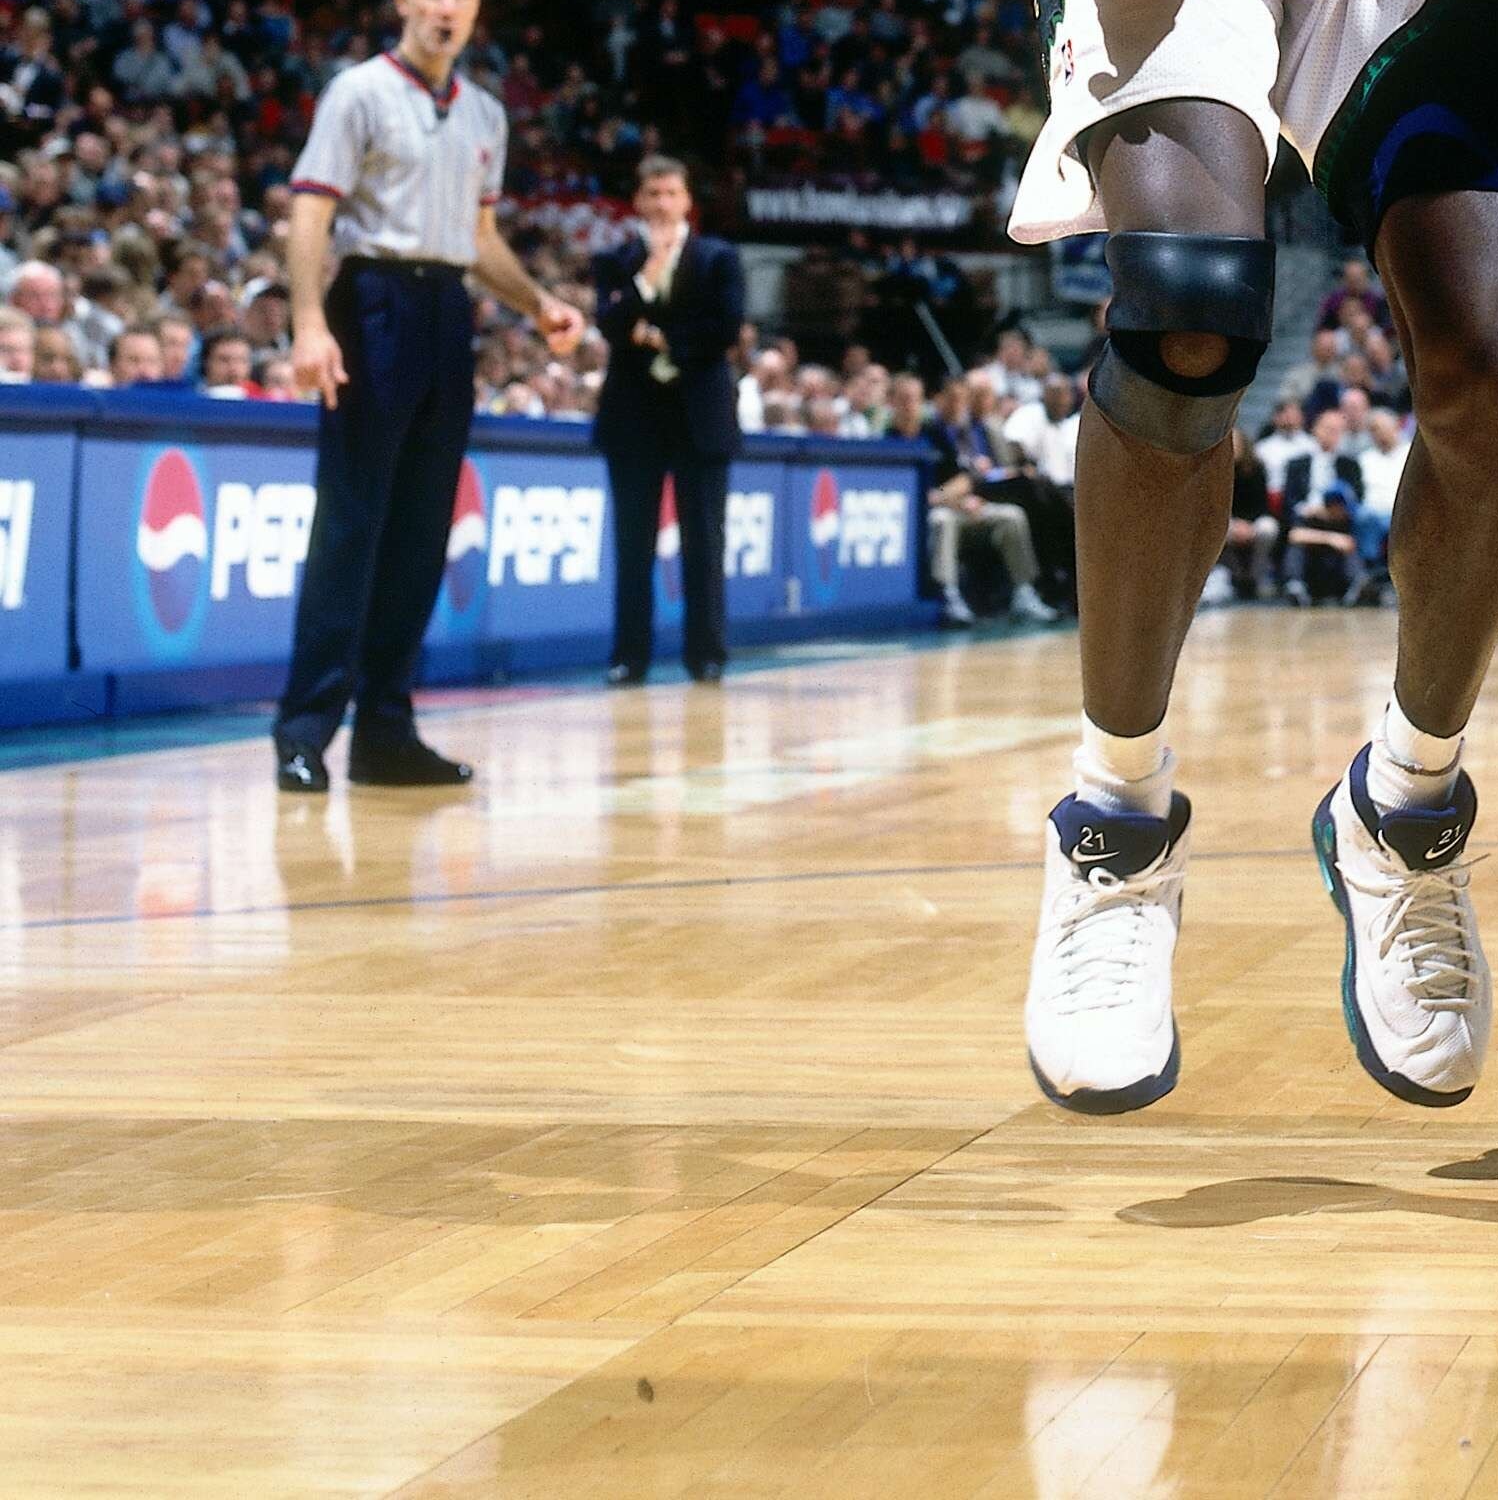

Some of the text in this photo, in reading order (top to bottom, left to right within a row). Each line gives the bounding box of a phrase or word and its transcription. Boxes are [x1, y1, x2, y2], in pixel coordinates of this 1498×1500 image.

[487, 486, 605, 586] PEPSI
[838, 490, 907, 568] PEPSI
[1081, 826, 1105, 851] 21
[1438, 823, 1463, 846] 21
